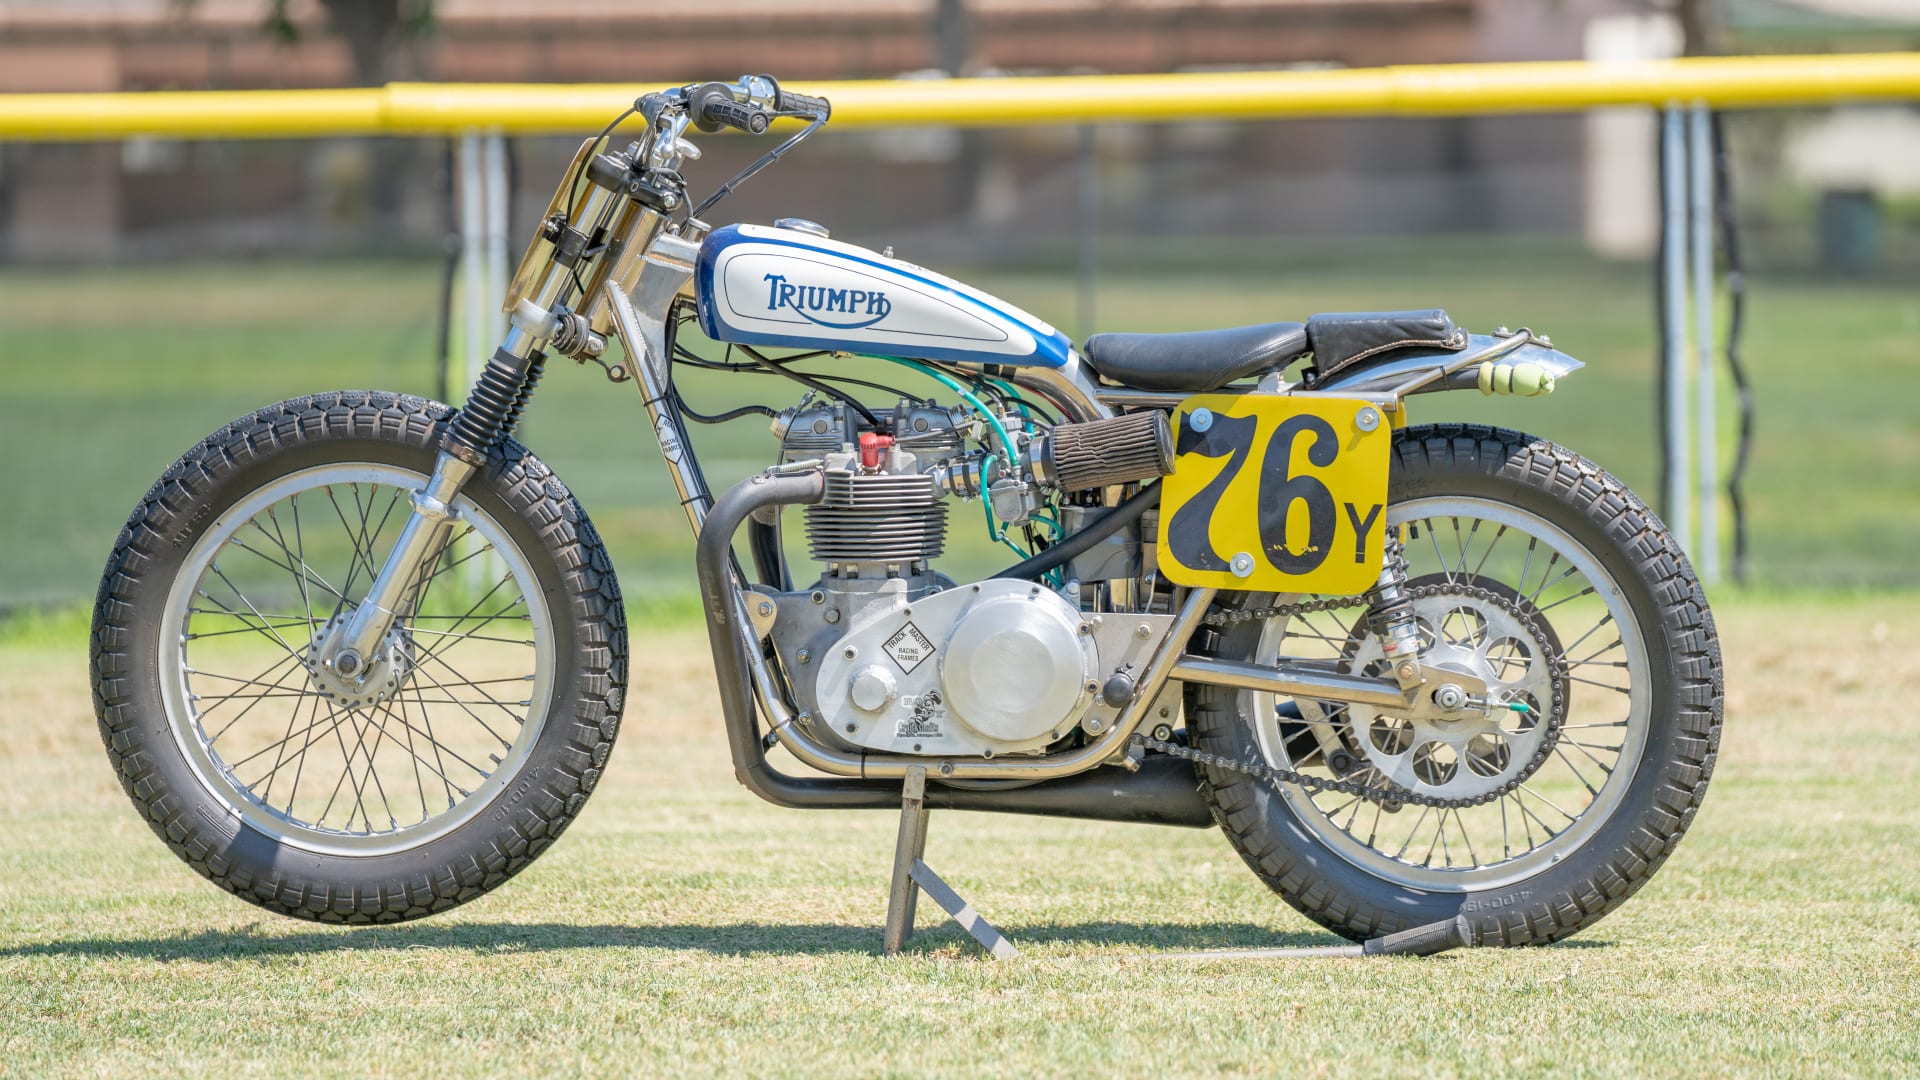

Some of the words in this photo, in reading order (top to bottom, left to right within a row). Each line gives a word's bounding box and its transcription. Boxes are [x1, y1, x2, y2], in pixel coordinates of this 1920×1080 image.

[763, 273, 892, 329] TRIUMPH
[1168, 409, 1339, 575] 76
[1343, 502, 1384, 564] Y
[887, 631, 907, 649] TRACK
[908, 628, 930, 651] MASTER
[898, 647, 919, 655] RACING
